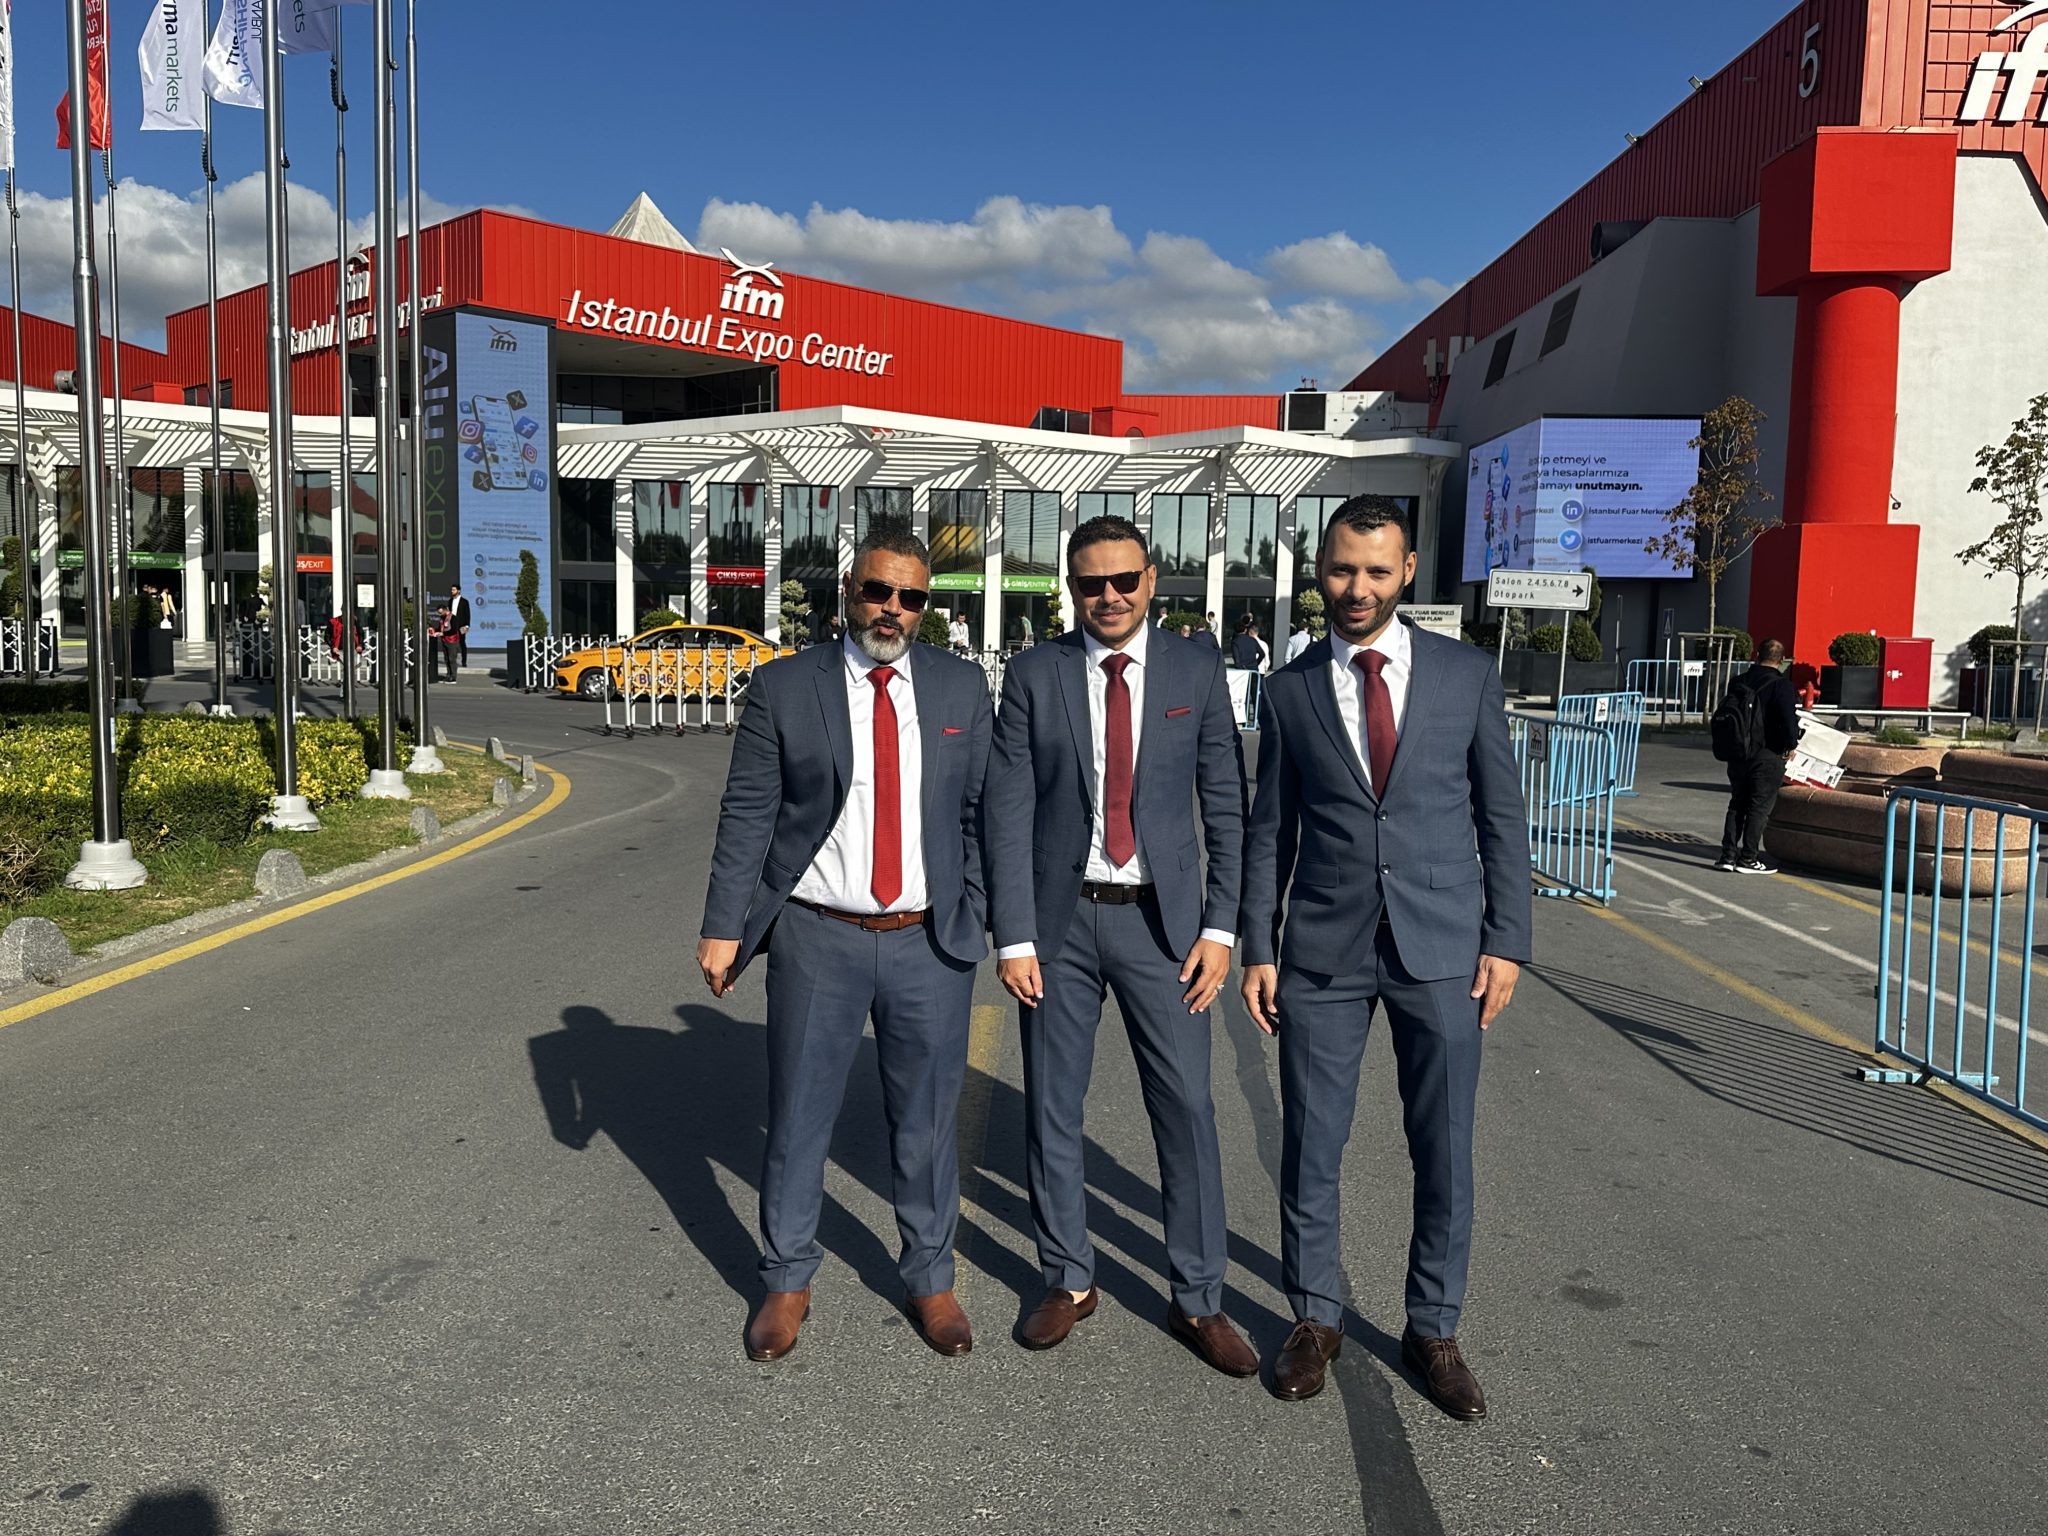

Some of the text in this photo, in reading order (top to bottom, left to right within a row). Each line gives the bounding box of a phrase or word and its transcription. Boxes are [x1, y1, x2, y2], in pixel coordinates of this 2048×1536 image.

[1798, 21, 1822, 98] 5
[1960, 21, 2048, 122] if
[165, 38, 183, 112] markets
[720, 275, 782, 319] ifm
[290, 314, 336, 356] tanbul
[567, 290, 893, 375] Istanbul Expo Center
[1552, 467, 1629, 479] hesaplarımıza
[1553, 456, 1591, 465] etmeyi
[1594, 456, 1607, 464] ve
[1575, 481, 1643, 493] unutmayın.
[1621, 507, 1639, 515] Fuar
[1495, 577, 1522, 585] Salon
[1494, 590, 1535, 600] Otopark
